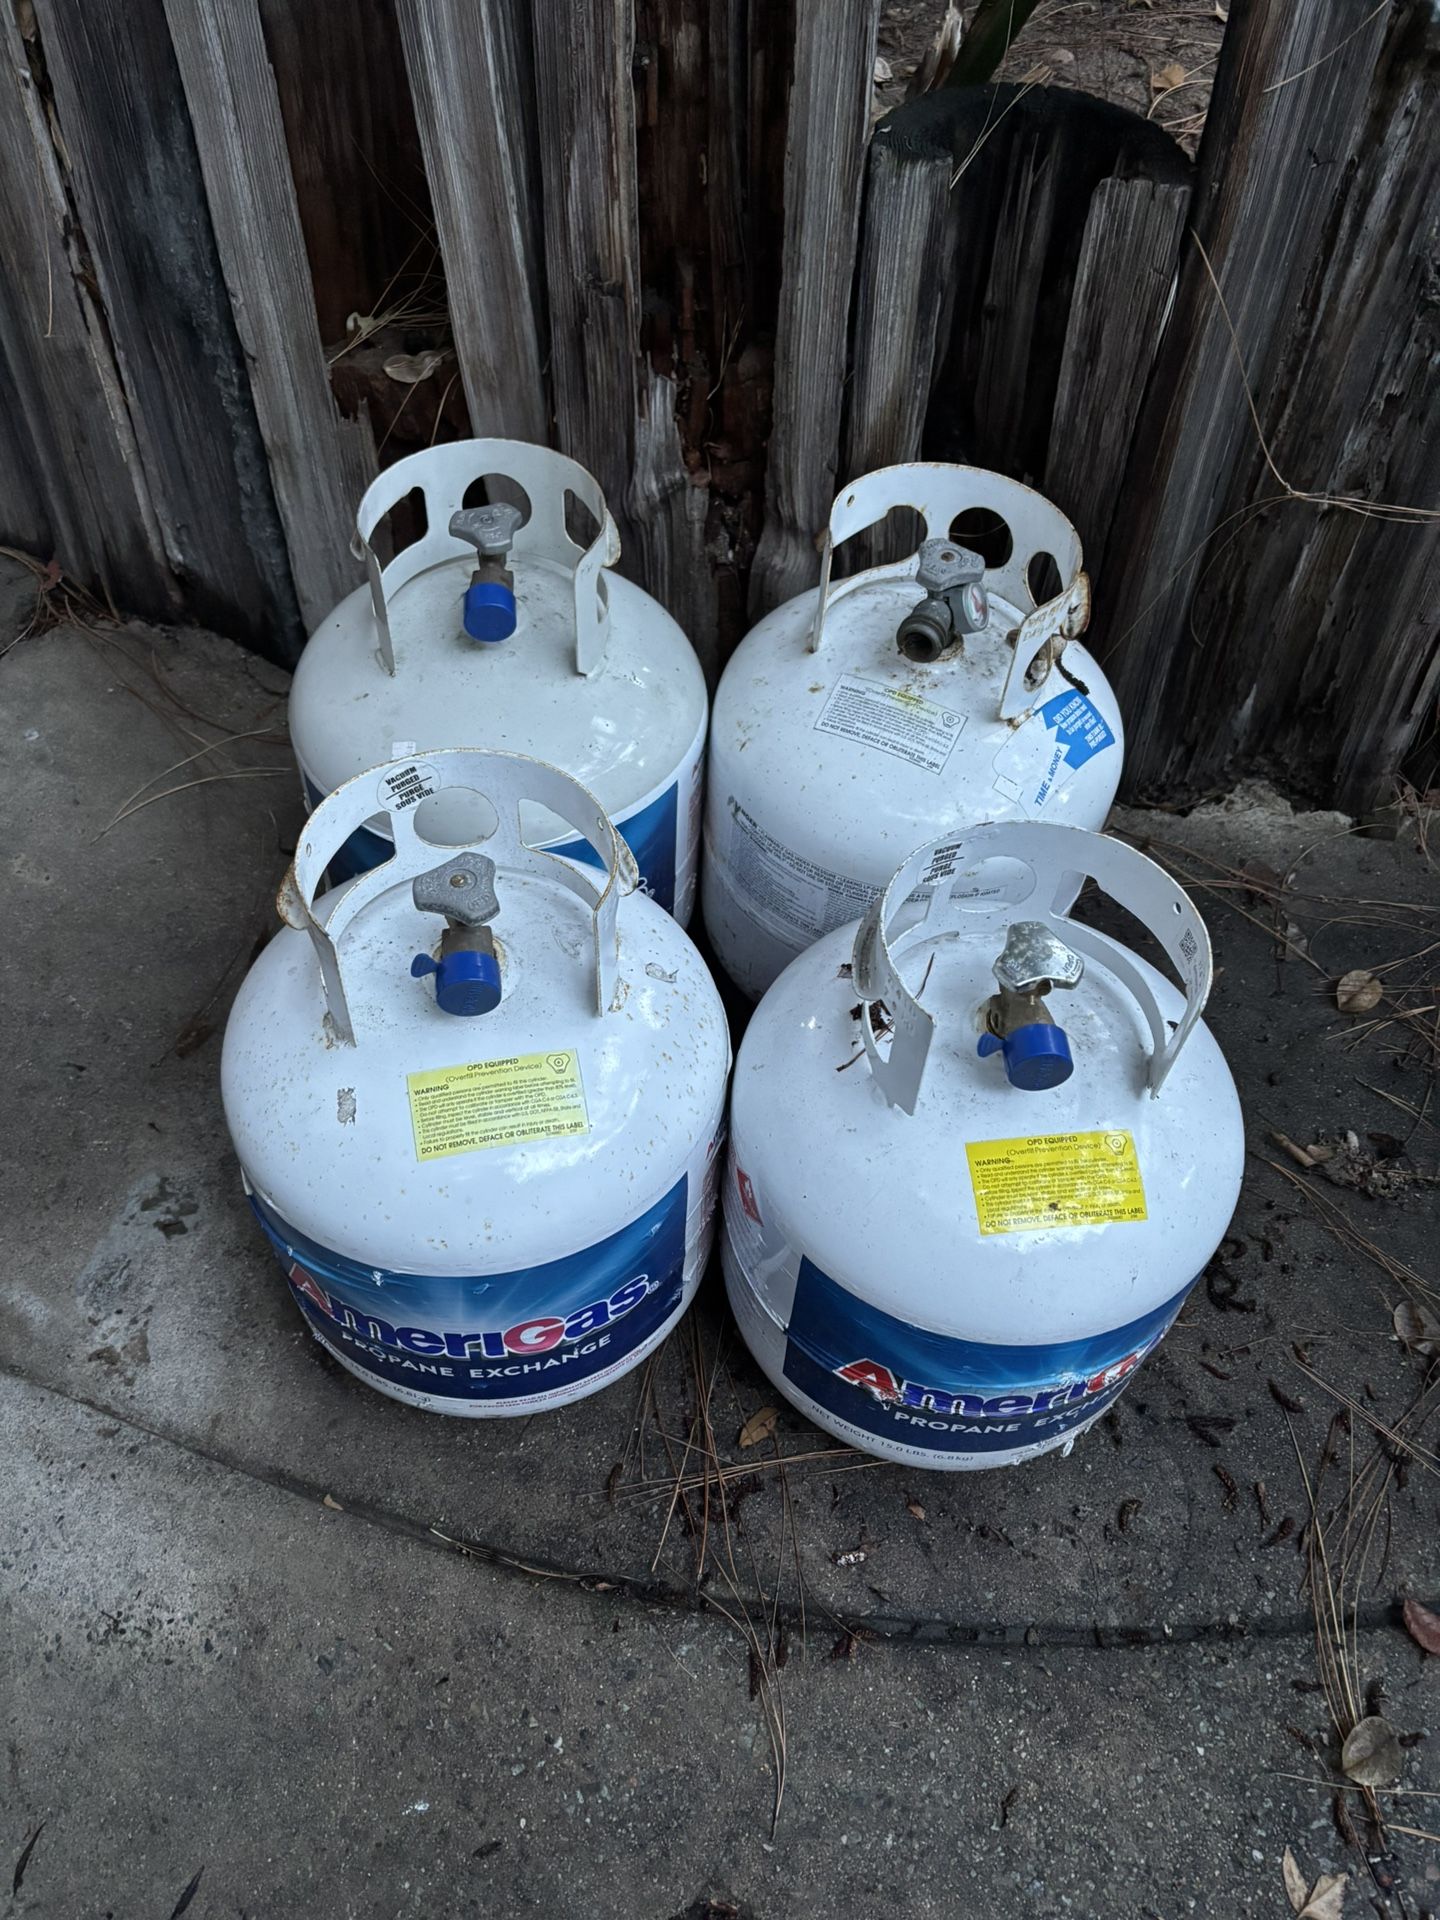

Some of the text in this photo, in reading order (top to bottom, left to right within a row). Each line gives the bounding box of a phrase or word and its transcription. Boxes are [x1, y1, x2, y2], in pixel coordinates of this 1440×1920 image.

[385, 766, 417, 786] VACUUM
[391, 775, 420, 792] PURGED
[1034, 781, 1050, 806] TIME
[1048, 747, 1063, 779] MONEY
[395, 788, 434, 810] SOUS VIDE
[467, 1058, 518, 1071] OPD EQUIPPED
[474, 1067, 512, 1078] Prevention
[433, 1143, 447, 1152] NOT
[449, 1137, 478, 1149] REMOVE,
[479, 1134, 503, 1144] DEFACE
[505, 1131, 514, 1139] OR
[516, 1126, 551, 1137] OBLITERATE
[566, 1121, 584, 1130] LABEL
[1027, 1135, 1077, 1146] OPD EQUIPPED
[1035, 1144, 1073, 1155] Prevention
[998, 1218, 1012, 1226] NOT
[1013, 1215, 1043, 1225] REMOVE,
[1044, 1214, 1068, 1222] DEFACE
[1079, 1210, 1113, 1218] OBLITERATE
[290, 1262, 650, 1359] AmeriGas
[342, 1331, 454, 1378] PROPANE
[470, 1334, 612, 1378] EXCHANGE
[811, 1404, 830, 1420] NET
[833, 1416, 876, 1443] WEIGHT
[879, 1440, 903, 1451] 15.0
[905, 1448, 929, 1458] LBS.
[894, 1412, 1021, 1434] PROPANE
